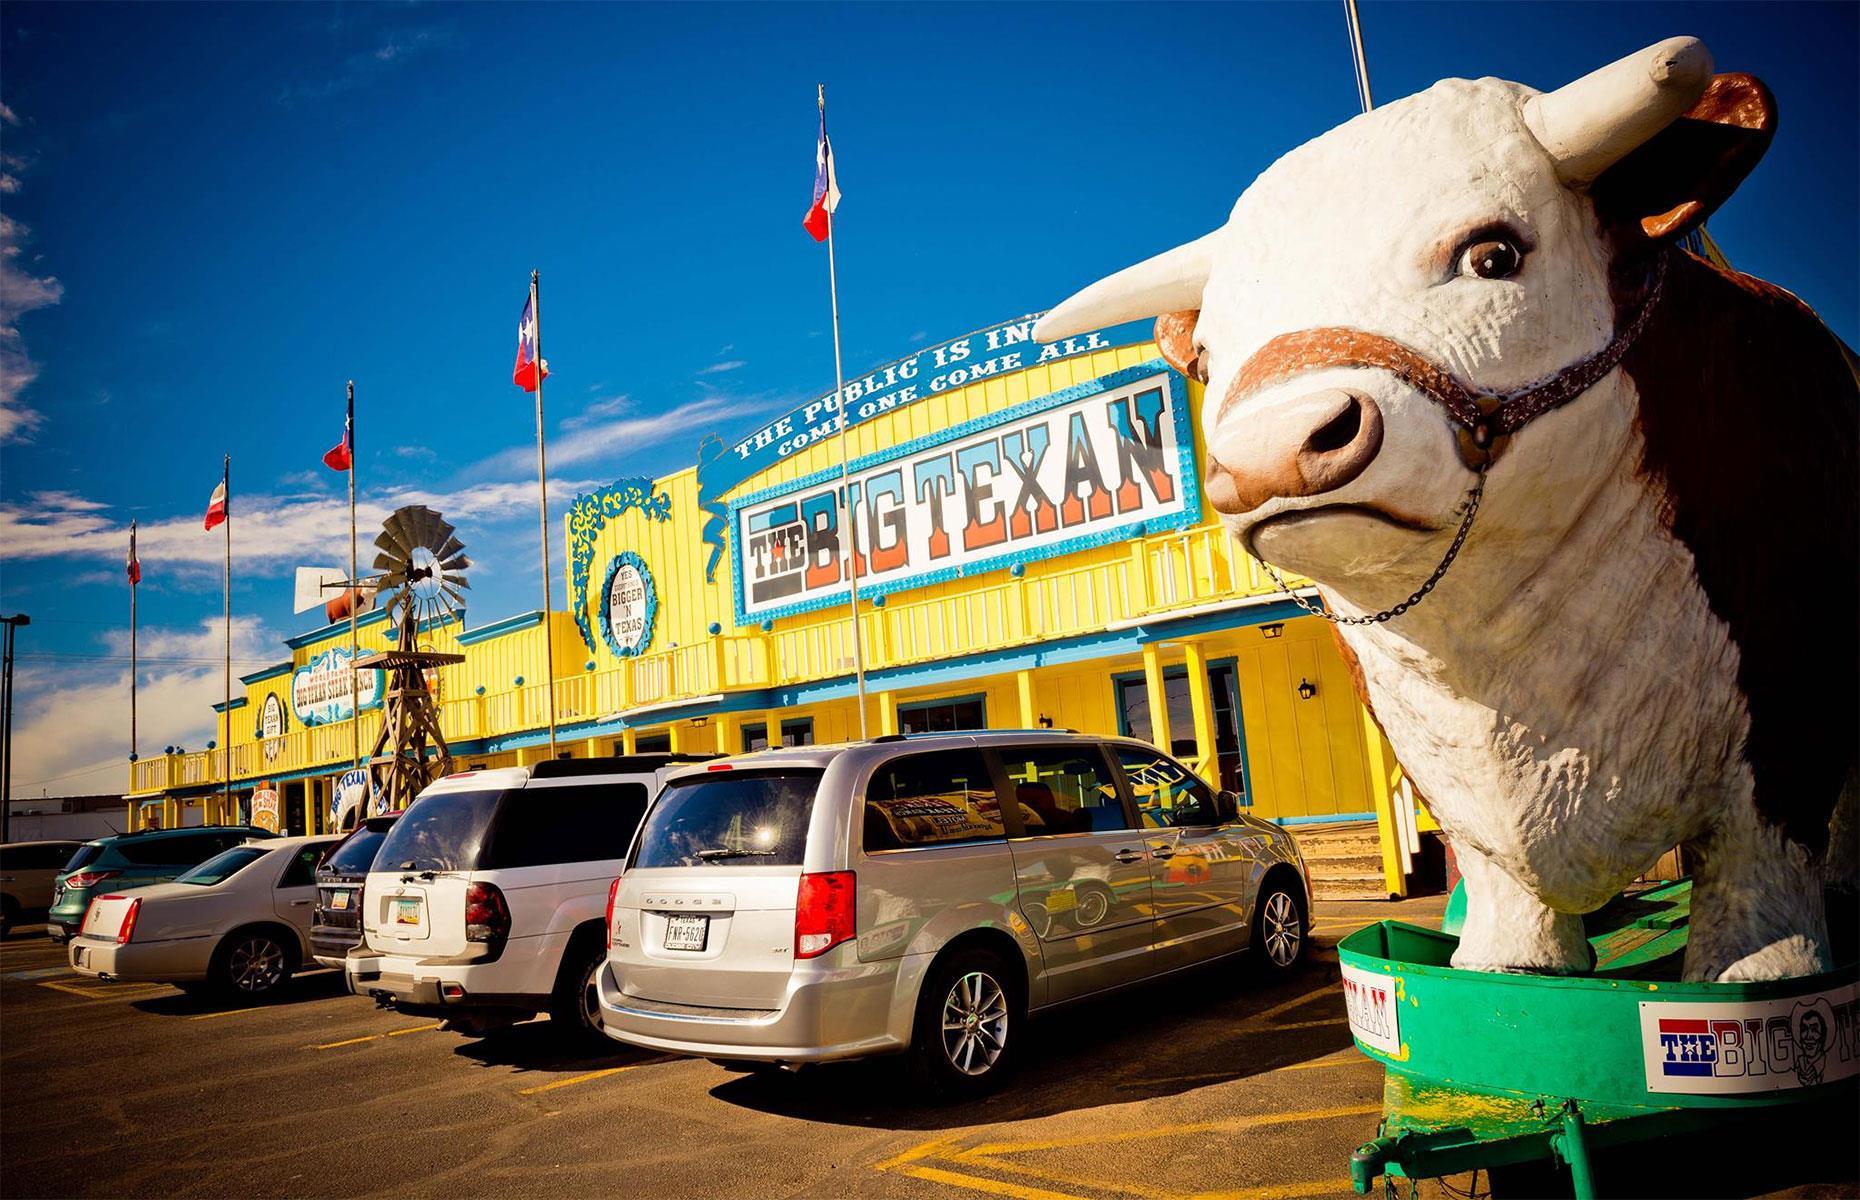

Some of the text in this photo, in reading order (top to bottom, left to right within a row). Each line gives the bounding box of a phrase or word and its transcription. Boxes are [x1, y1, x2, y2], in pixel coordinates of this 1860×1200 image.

[735, 416, 793, 460] THE
[803, 357, 918, 424] PUBLIC
[932, 339, 971, 368] IS
[777, 332, 1110, 456] COME ONE COME ALL
[750, 386, 1175, 591] THE BIG TEXAN
[612, 587, 643, 607] BIGGER
[620, 570, 633, 581] YES
[615, 618, 642, 635] TEXAS
[296, 687, 307, 708] BIG
[307, 681, 327, 705] TEXAN
[327, 675, 349, 700] STEAK
[1660, 1033, 1716, 1062] THE
[1710, 1016, 1795, 1078] BIG
